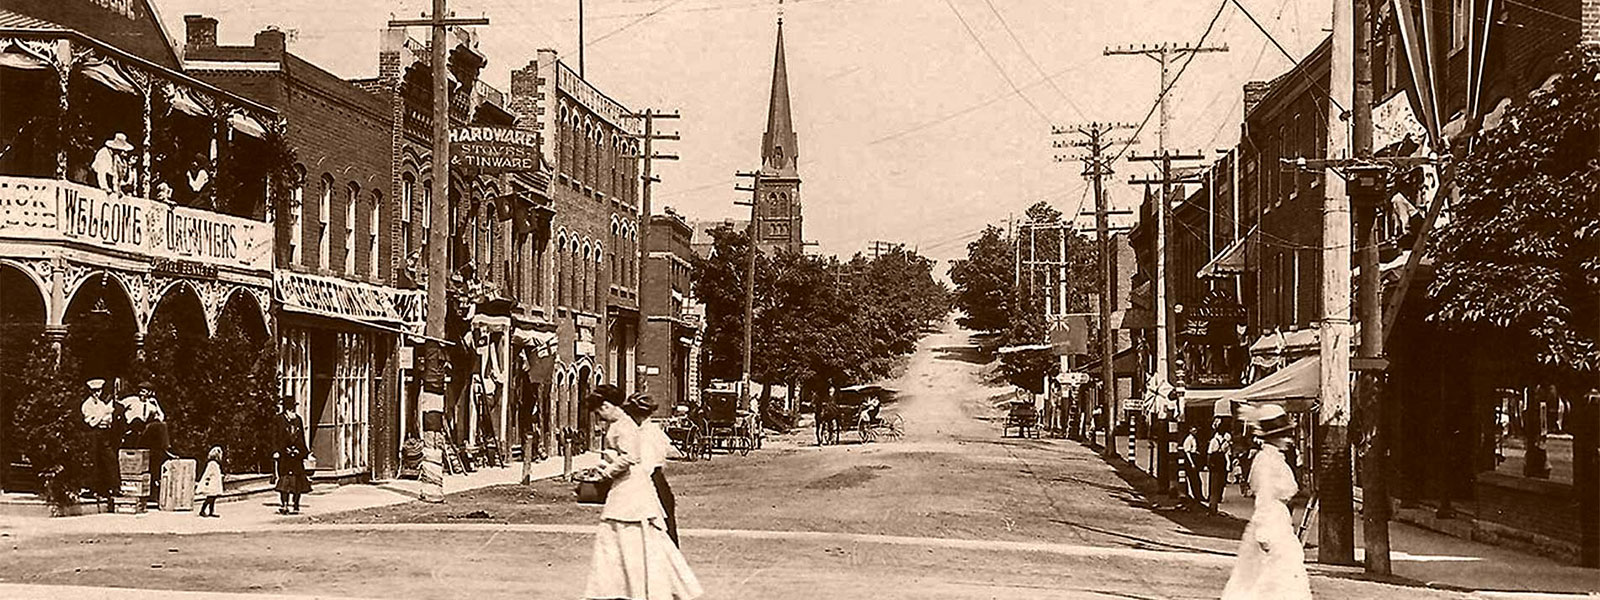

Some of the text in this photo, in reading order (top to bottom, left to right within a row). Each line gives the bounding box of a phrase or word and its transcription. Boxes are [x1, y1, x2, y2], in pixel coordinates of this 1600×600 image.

[448, 127, 537, 147] HARDWARE
[450, 154, 532, 169] & TINWARE
[63, 188, 142, 246] WELCOME
[166, 209, 238, 259] DRUMMERS
